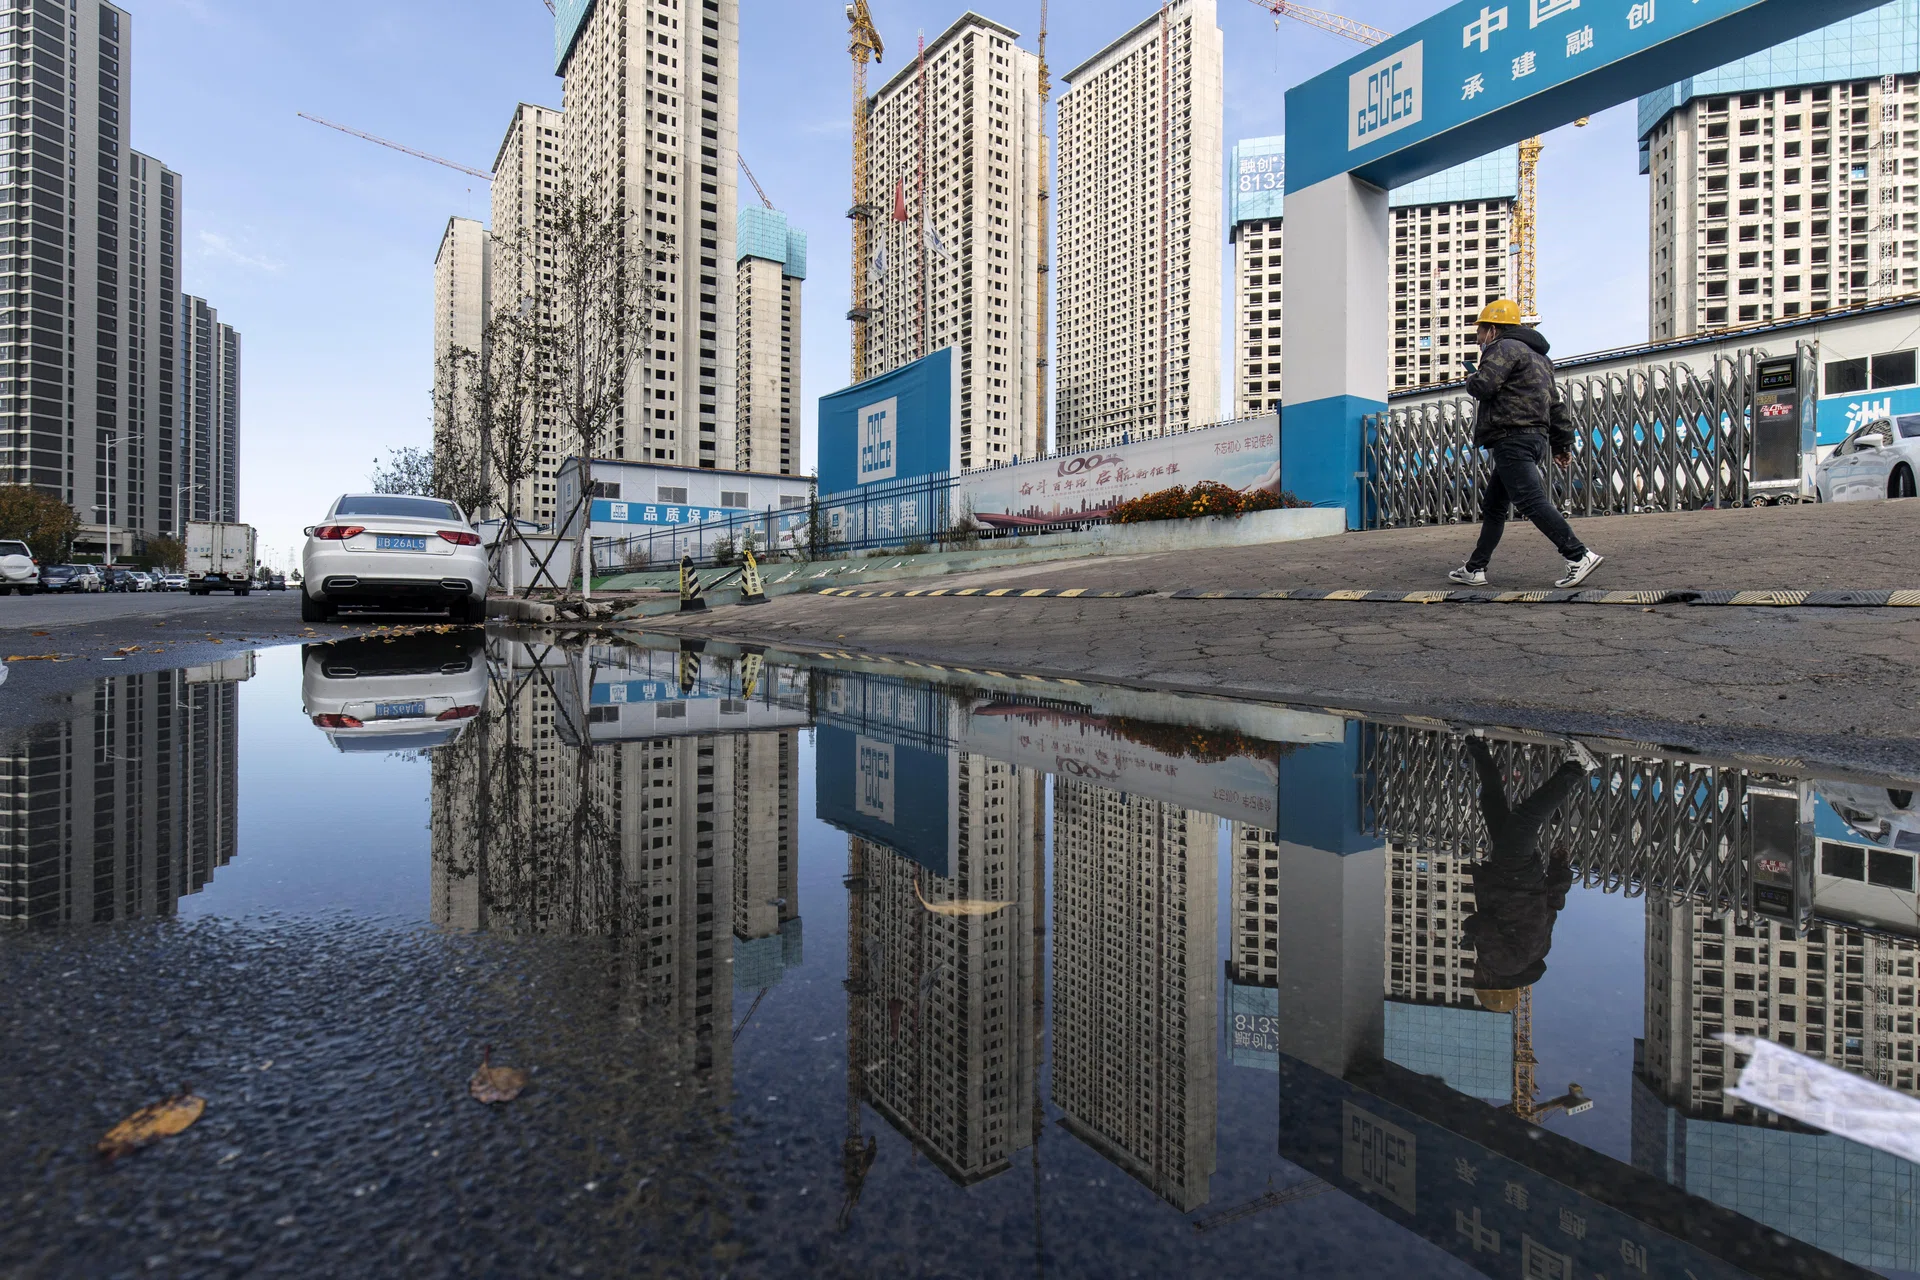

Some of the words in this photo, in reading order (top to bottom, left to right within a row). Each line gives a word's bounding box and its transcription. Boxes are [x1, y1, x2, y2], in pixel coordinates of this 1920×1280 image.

[1461, 0, 1699, 100] 承建融创
[1214, 440, 1241, 455] 不忘初心
[1244, 433, 1274, 450] 牢记使命
[1019, 478, 1088, 496] 奋斗百年路
[643, 506, 723, 525] 品质保障
